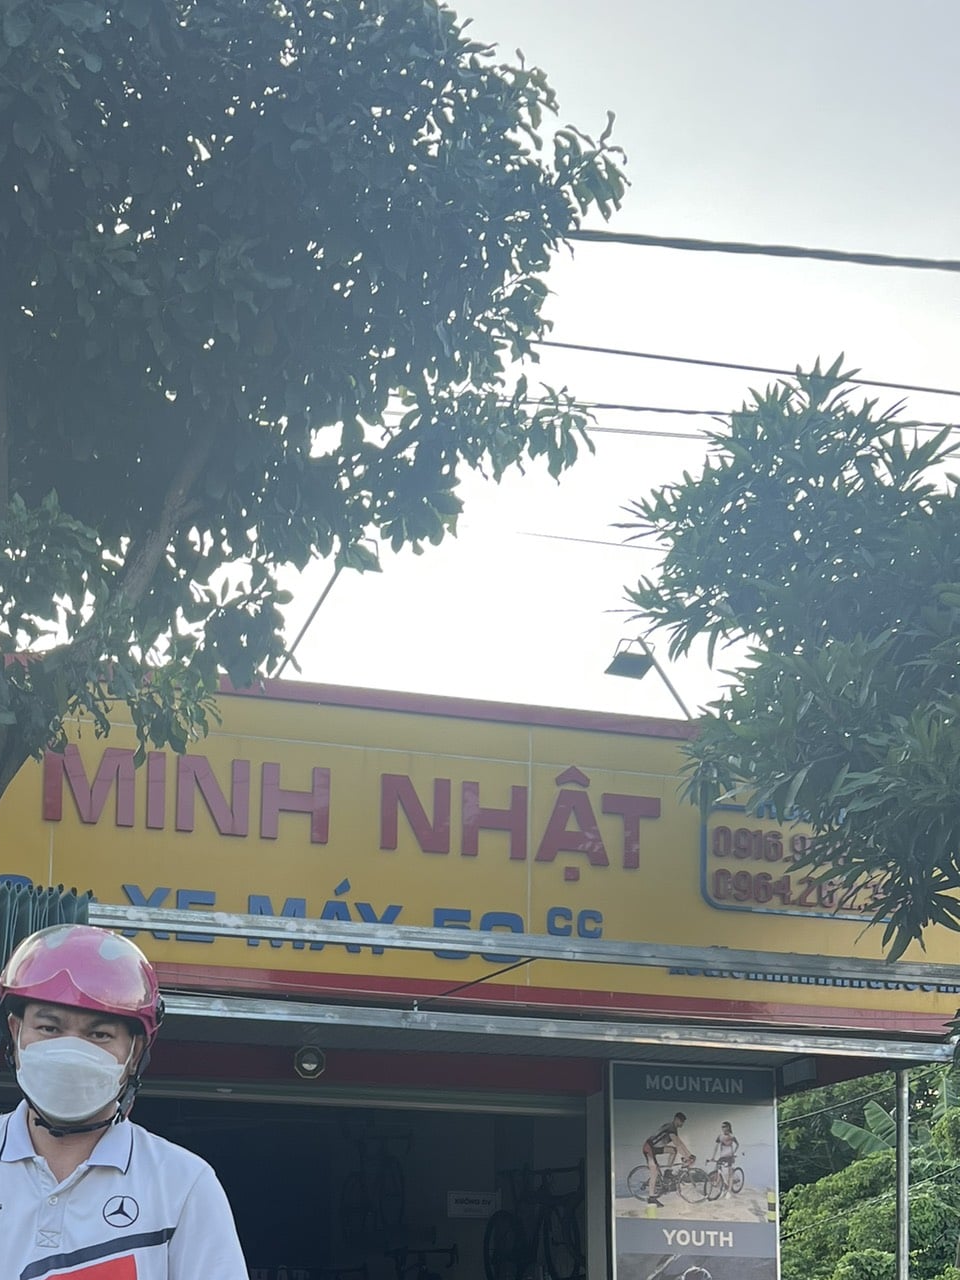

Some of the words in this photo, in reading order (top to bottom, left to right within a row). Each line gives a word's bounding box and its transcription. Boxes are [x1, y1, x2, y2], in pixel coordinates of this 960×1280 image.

[43, 743, 330, 844] MINH
[379, 765, 661, 881] NHẬT
[645, 1073, 745, 1095] MOUNTAIN
[662, 1228, 734, 1249] YOUTH
